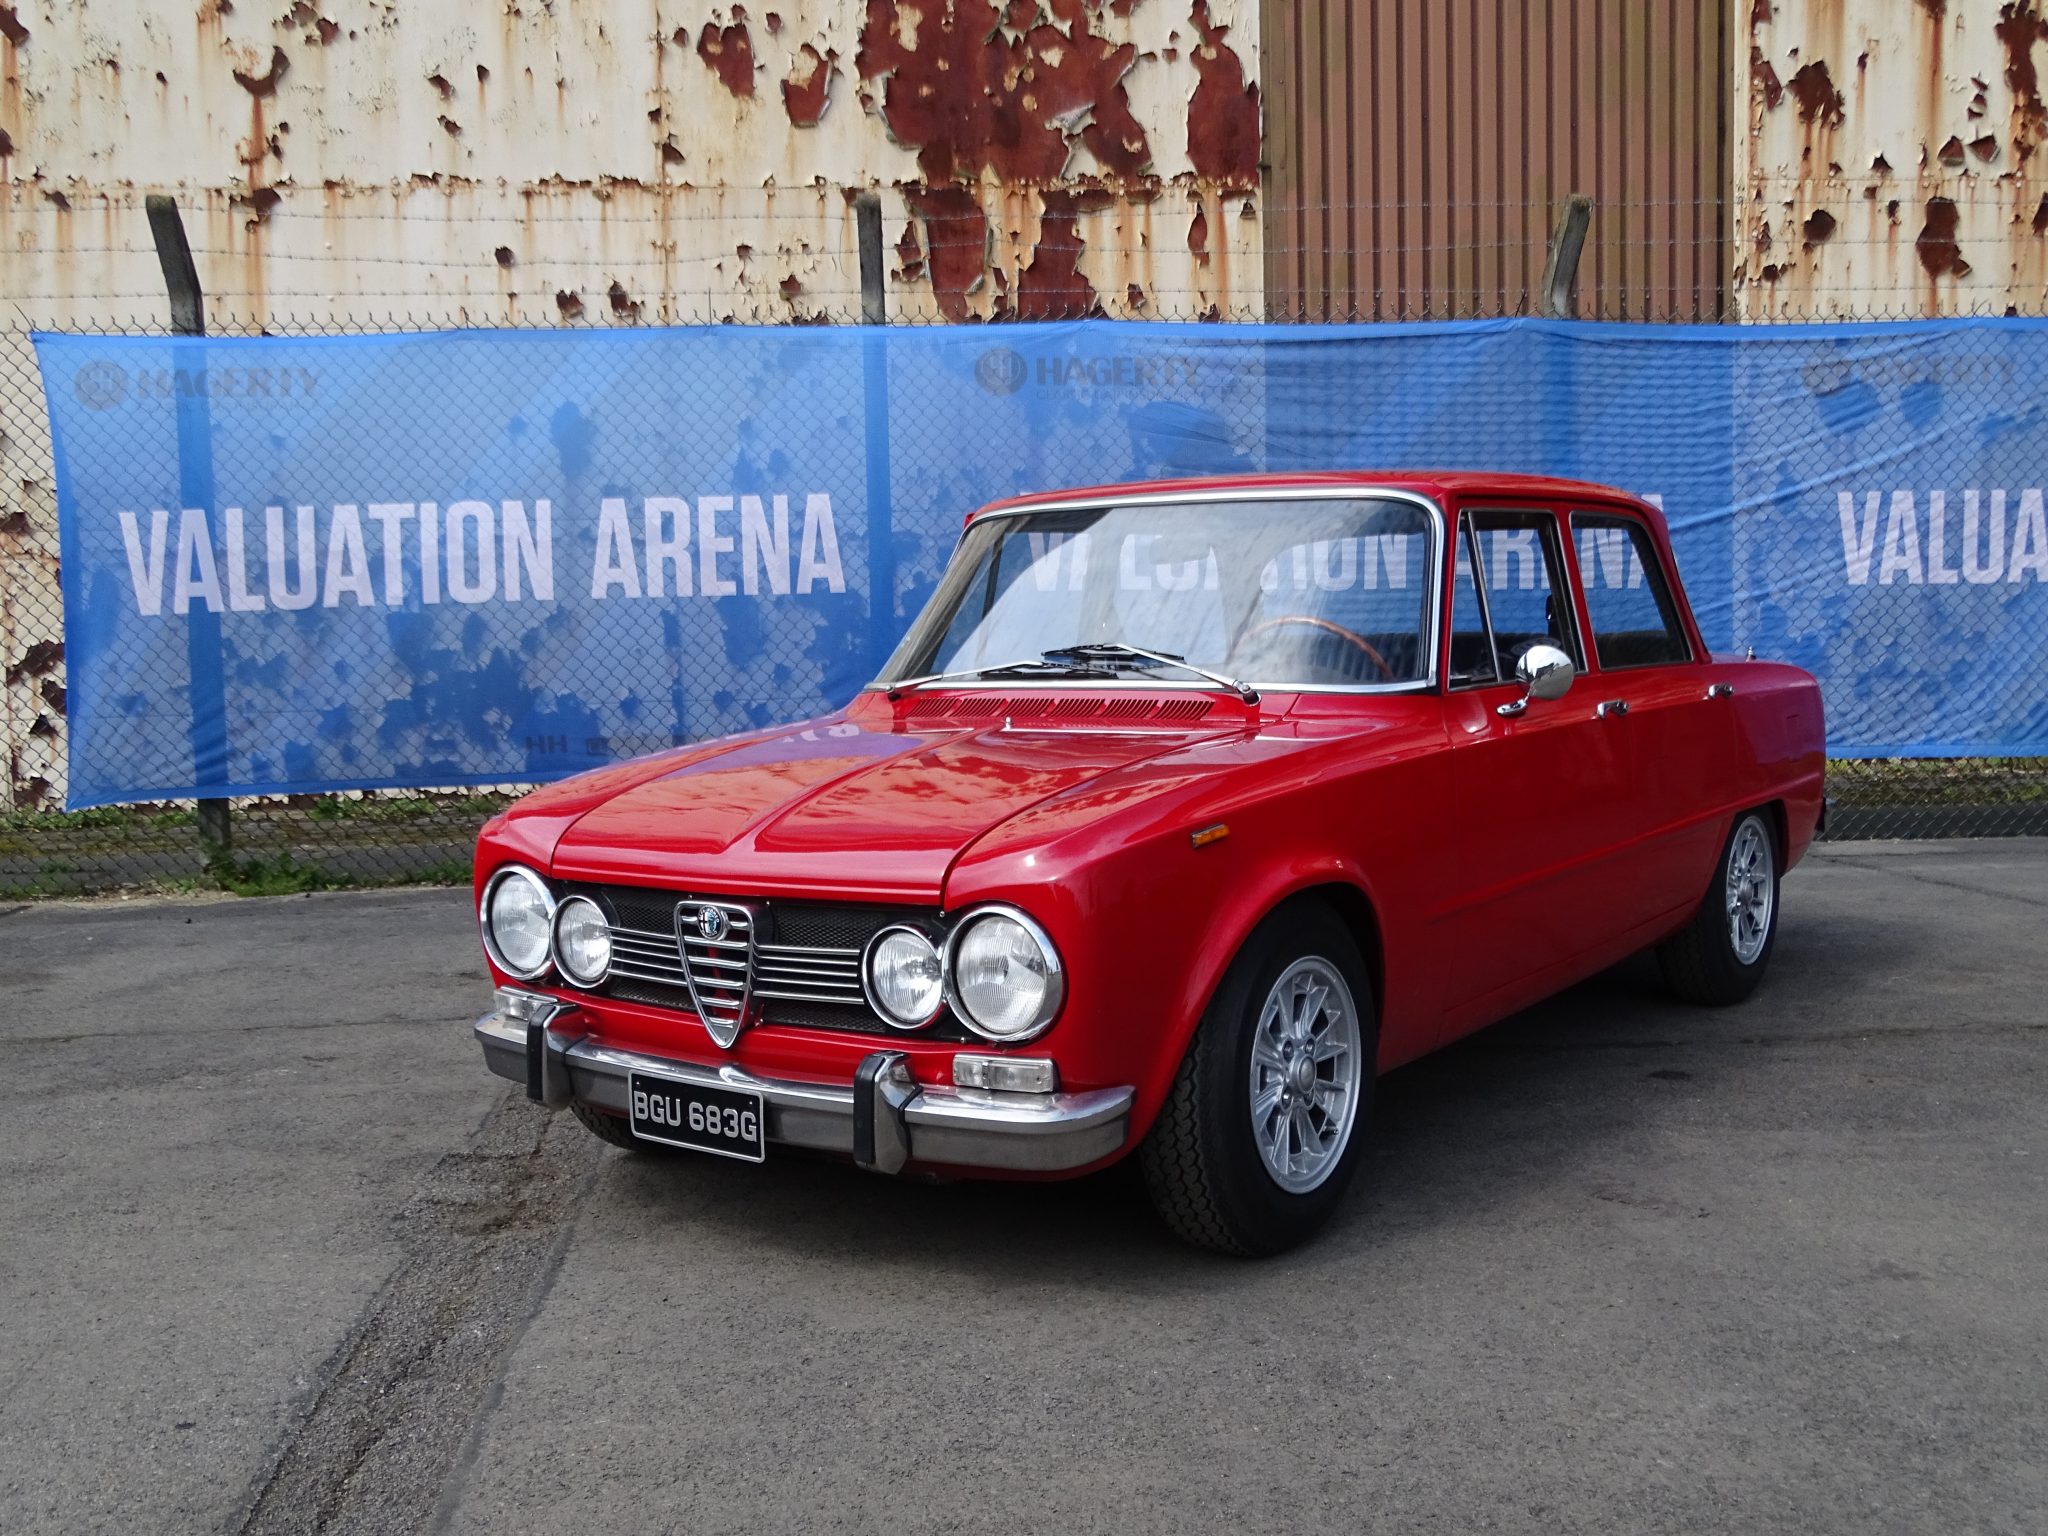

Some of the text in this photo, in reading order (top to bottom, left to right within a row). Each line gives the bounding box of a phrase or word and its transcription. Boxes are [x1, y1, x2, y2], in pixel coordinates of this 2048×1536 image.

[118, 493, 847, 616] VALUATION ARENA
[634, 1091, 758, 1142] BGU 683G
